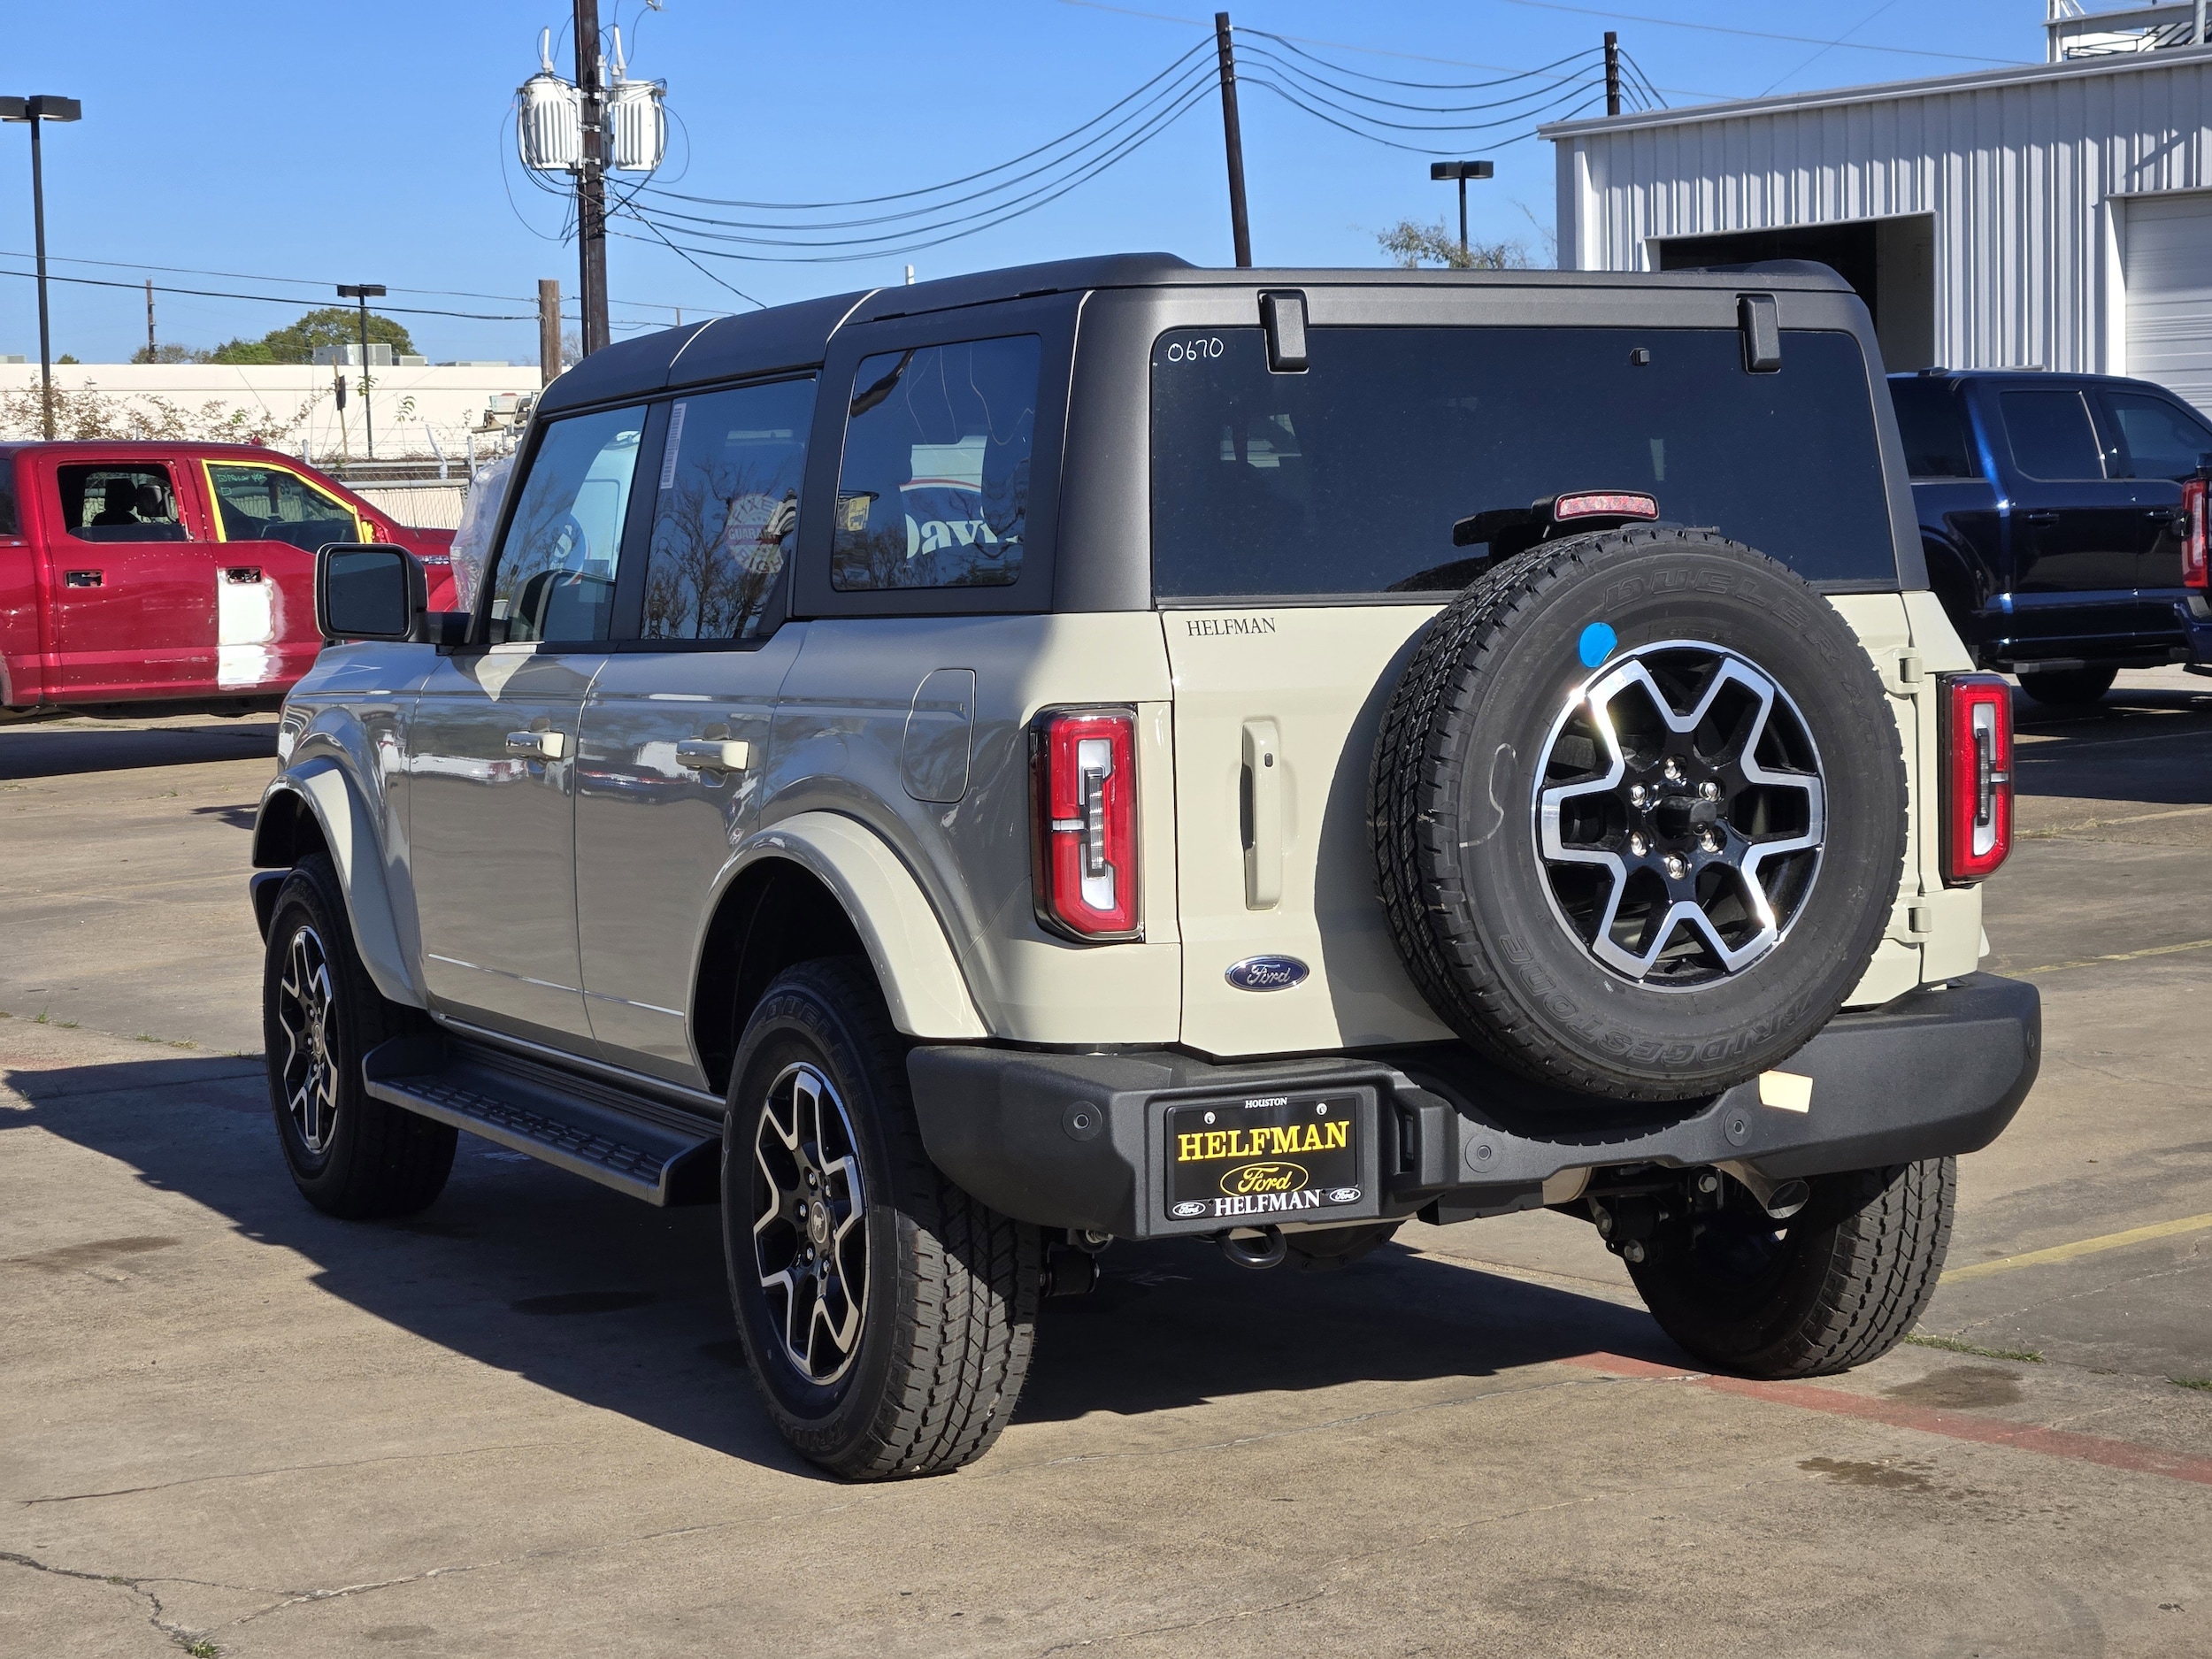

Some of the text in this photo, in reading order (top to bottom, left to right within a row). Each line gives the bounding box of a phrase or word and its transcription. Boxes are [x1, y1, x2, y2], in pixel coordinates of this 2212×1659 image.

[1167, 337, 1225, 362] 0670
[732, 496, 774, 524] FIXE
[1186, 618, 1277, 636] HELFMAN
[1604, 568, 1844, 665] DUELER
[1246, 964, 1291, 985] Ford
[1499, 933, 1812, 1067] BRIDGESTONE
[1244, 1097, 1288, 1109] HOUSTON
[1178, 1120, 1350, 1162] HELFMAN
[1238, 1166, 1294, 1193] Ford
[1214, 1189, 1322, 1217] HELFMAN
